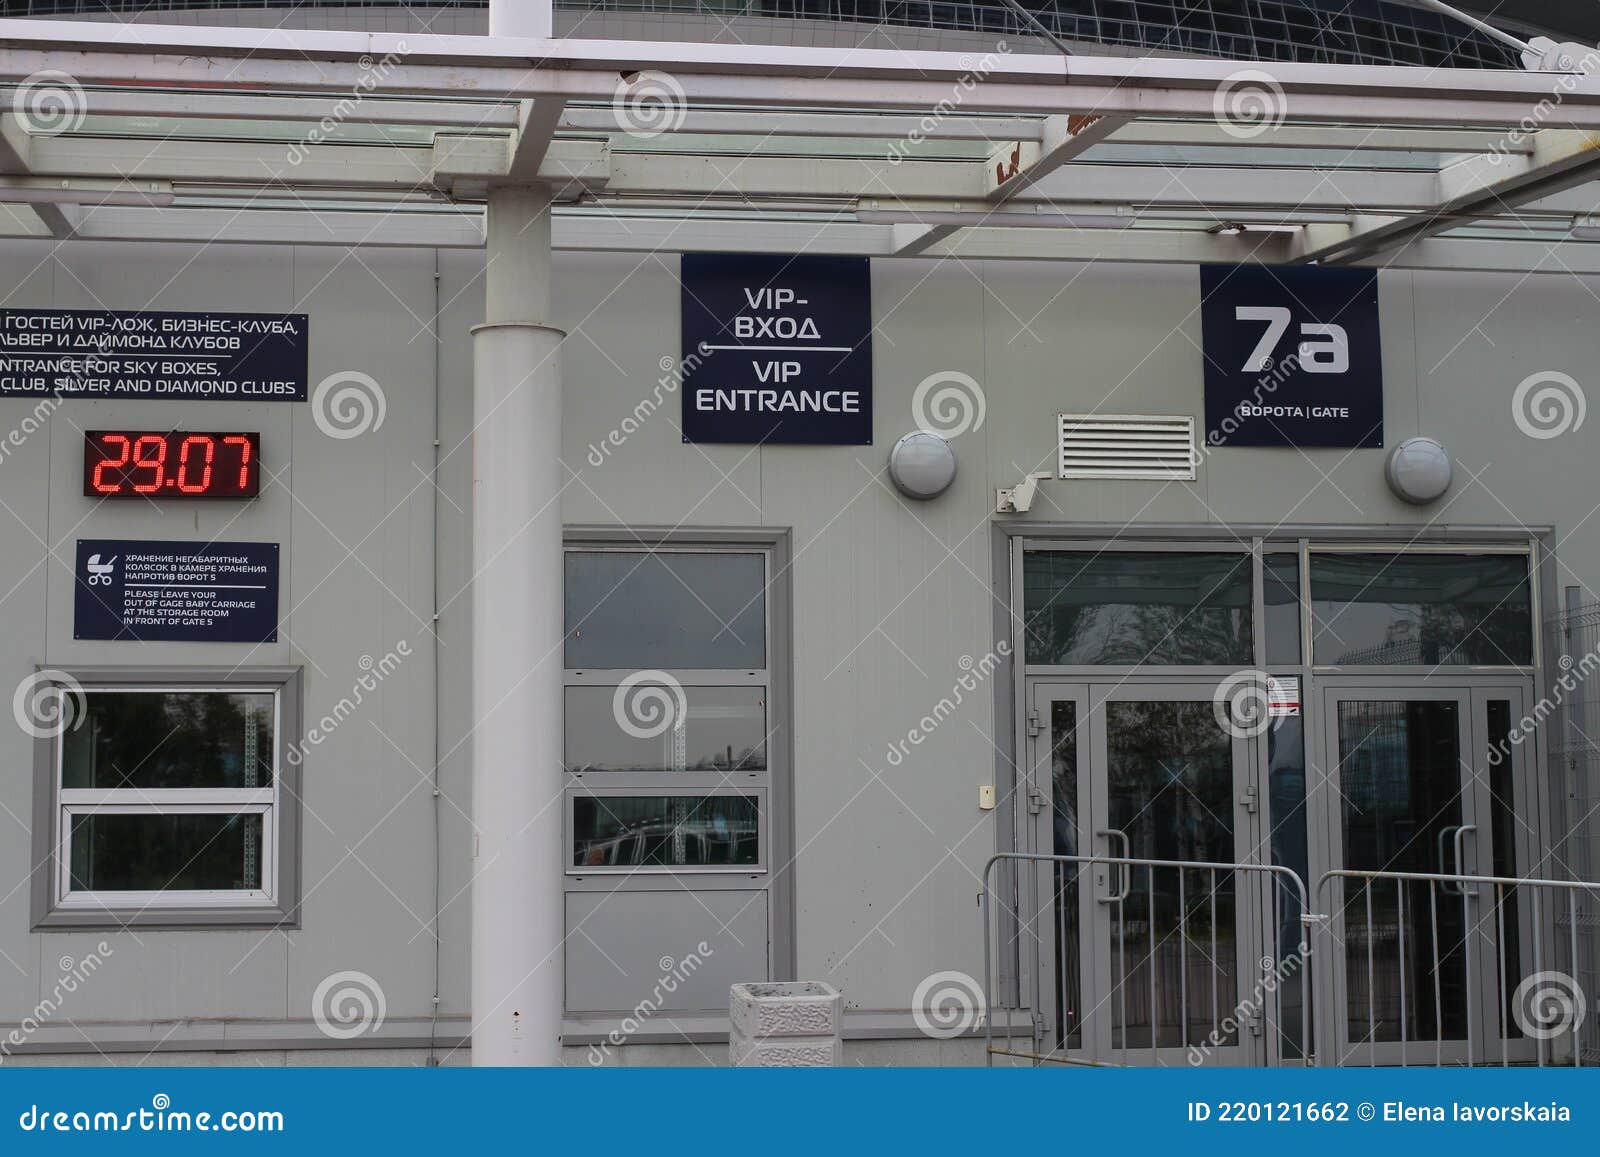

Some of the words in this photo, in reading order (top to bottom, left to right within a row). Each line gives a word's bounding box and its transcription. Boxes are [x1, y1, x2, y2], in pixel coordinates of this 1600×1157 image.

[744, 287, 808, 309] VIP-
[5, 313, 73, 330] ГОСТЕЙ
[77, 317, 158, 333] VIP-ЛОЖ,
[162, 319, 298, 336] БИЗНЕС-КЛУБА,
[735, 316, 821, 339] ВХОД
[57, 334, 70, 346] И
[73, 332, 167, 348] ДАЙМОНД
[170, 336, 241, 350] КЛУБОВ
[85, 360, 120, 374] FOR
[124, 361, 157, 375] SKY
[161, 362, 221, 378] BOXES,
[752, 361, 801, 382] VIP
[1, 377, 49, 392] CLUB,
[54, 378, 111, 392] SILVER
[114, 379, 151, 393] AND
[155, 380, 237, 394] DIAMOND
[241, 381, 296, 394] CLUBS
[696, 389, 860, 412] ENTRANCE
[1241, 406, 1304, 417] ВОРОТА
[1312, 407, 1349, 418] GATE
[93, 435, 250, 492] 29.07
[175, 556, 248, 564] НЕГАБАРИТНЫХ
[177, 573, 209, 581] ВОРОТ
[191, 591, 216, 599] YOUR
[185, 600, 210, 608] BABY
[211, 601, 256, 609] CARRIAGE
[200, 609, 229, 617] ROOM
